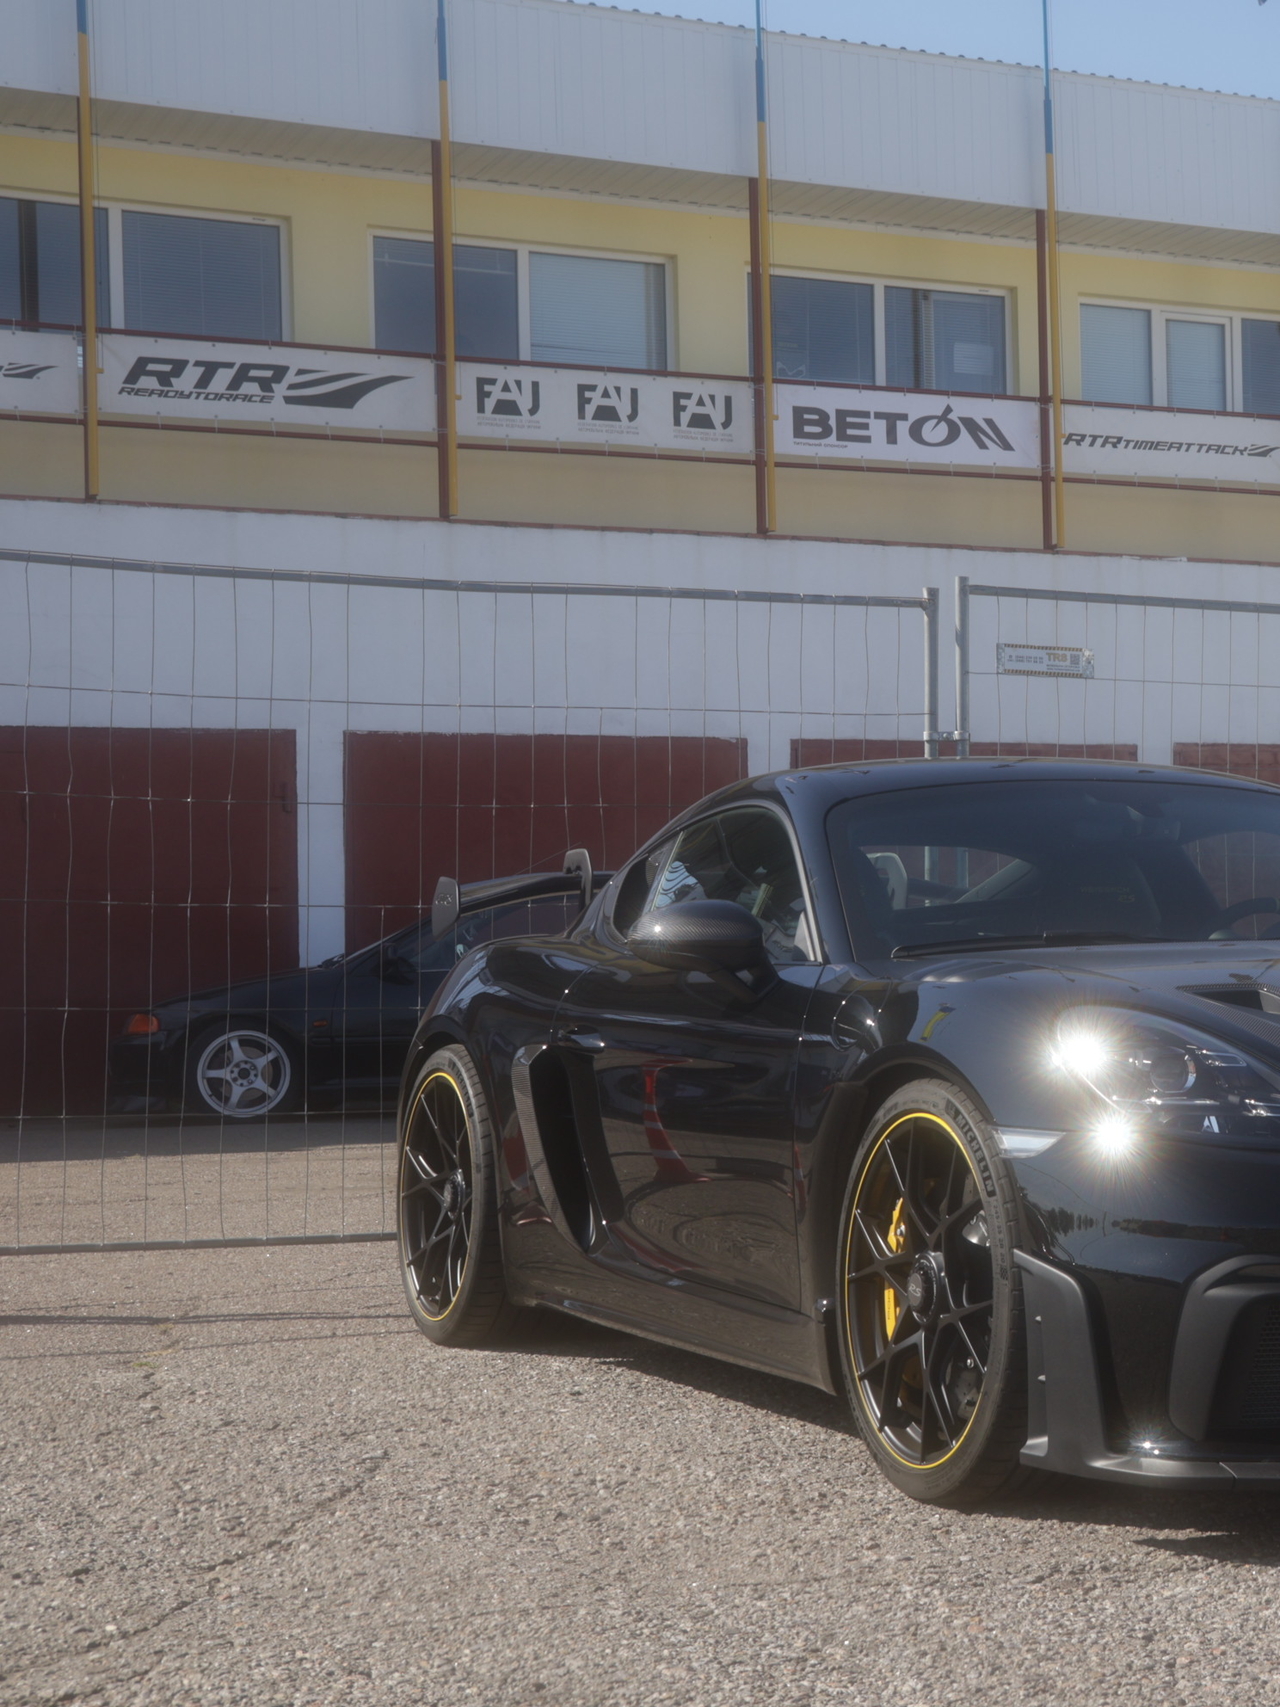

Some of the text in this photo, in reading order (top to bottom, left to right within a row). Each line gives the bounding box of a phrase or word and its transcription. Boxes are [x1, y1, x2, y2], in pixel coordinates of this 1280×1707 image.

[122, 356, 290, 393] RTR
[118, 386, 275, 404] READYTORACE
[955, 1114, 994, 1193] MICHELIN
